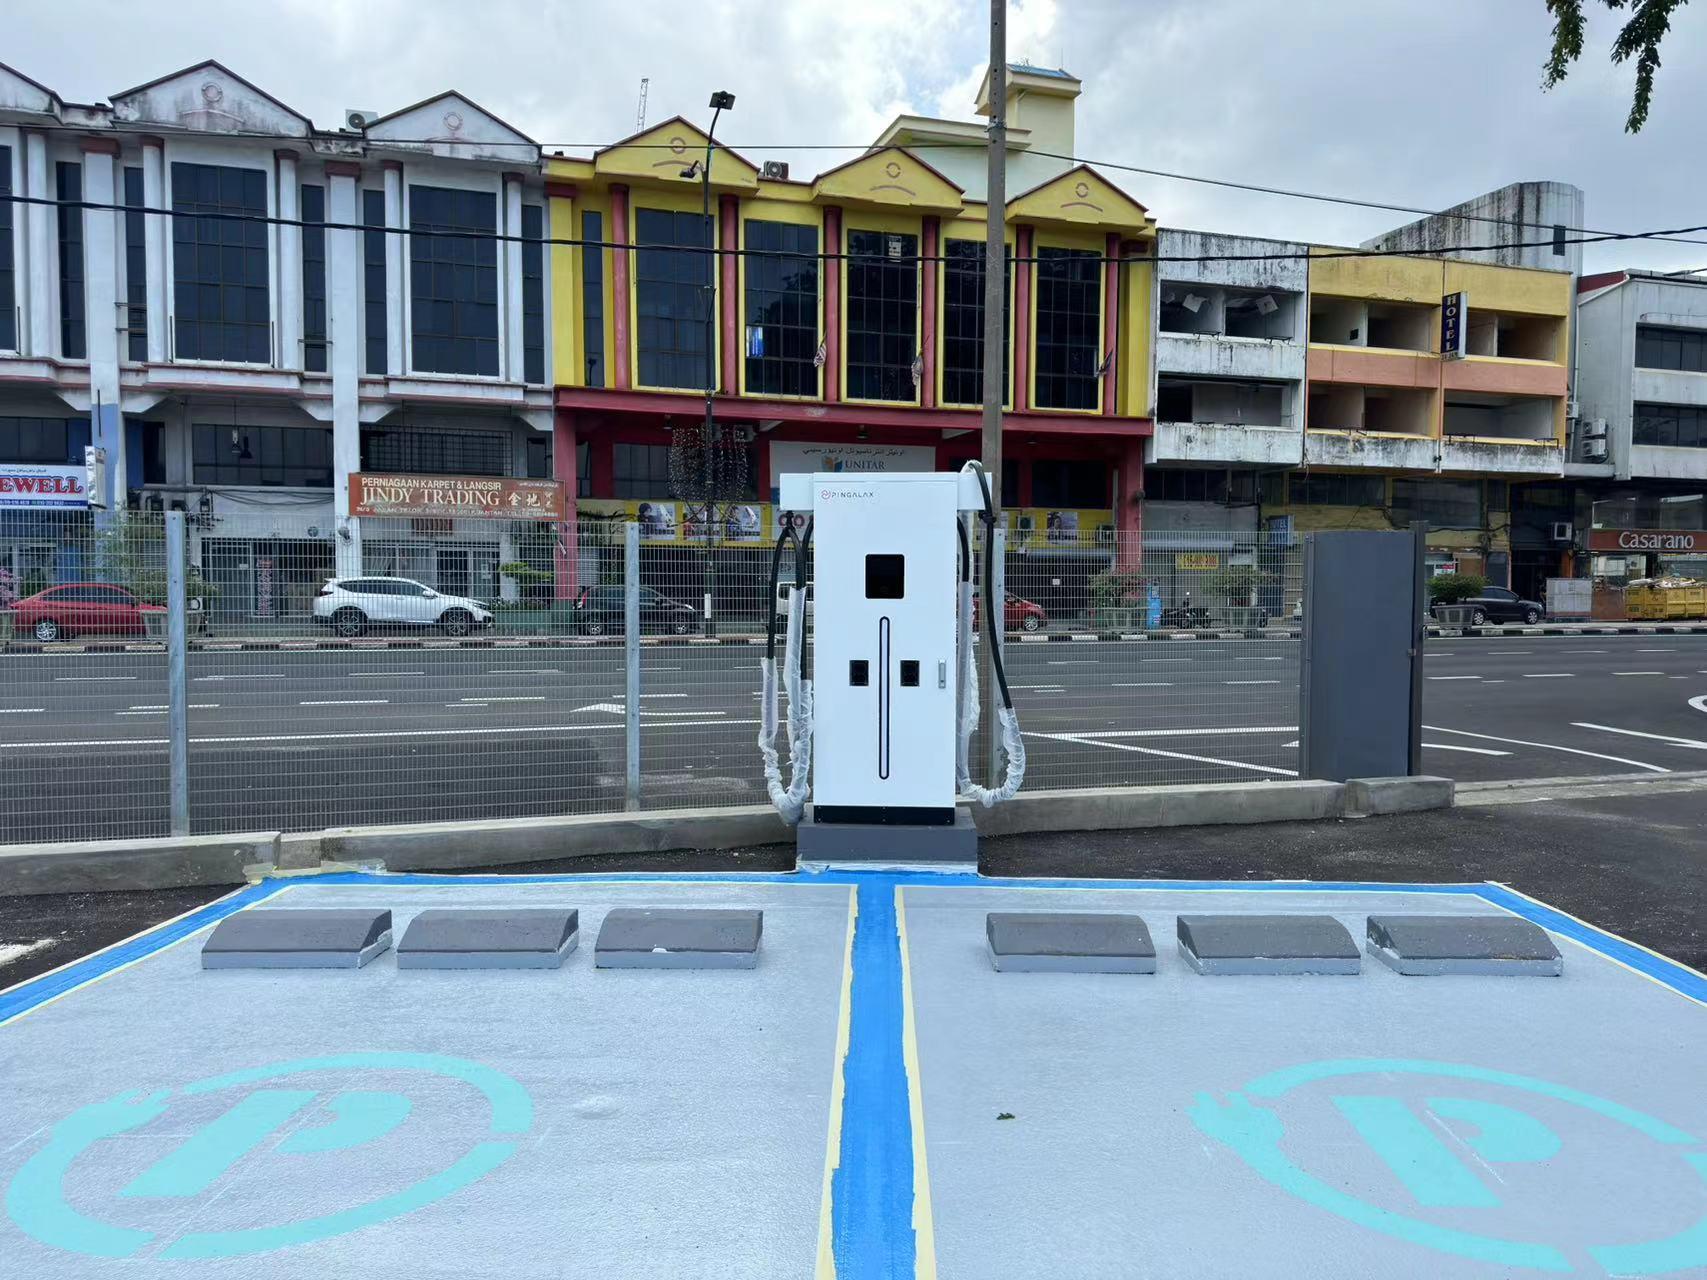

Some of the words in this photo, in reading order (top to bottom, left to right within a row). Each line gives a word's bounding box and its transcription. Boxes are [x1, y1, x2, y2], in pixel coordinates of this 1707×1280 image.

[1445, 295, 1457, 351] HOTEL
[845, 460, 885, 470] UNITAR
[361, 477, 419, 488] PERNIAGAAN
[420, 479, 455, 489] KARPET
[456, 481, 462, 489] &
[464, 481, 502, 490] LANGSIR
[360, 487, 413, 505] JINDY
[420, 489, 500, 506] TRADING
[1619, 531, 1695, 549] Casarano
